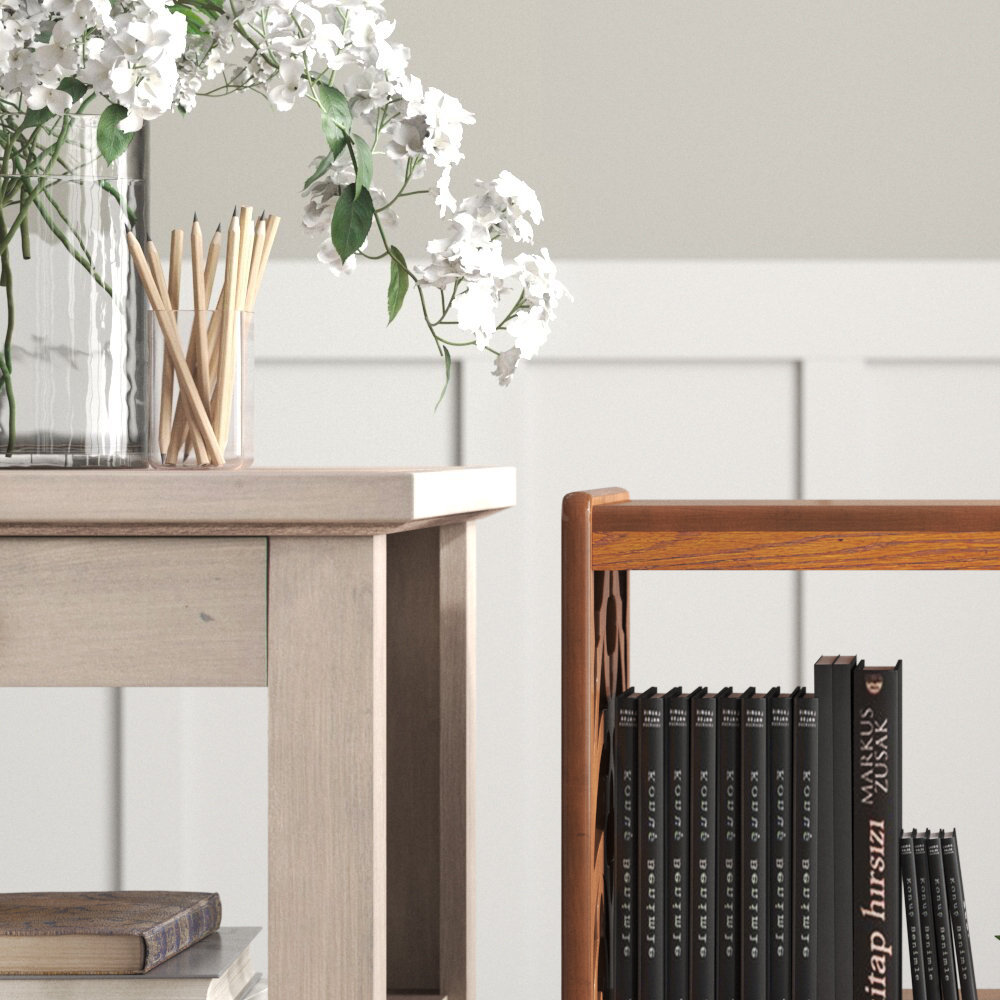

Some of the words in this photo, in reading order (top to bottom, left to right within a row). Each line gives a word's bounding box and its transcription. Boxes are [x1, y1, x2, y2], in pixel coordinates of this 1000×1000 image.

[860, 708, 874, 804] MARKUS
[874, 718, 889, 794] ZUSAK
[861, 819, 886, 921] hırsızı
